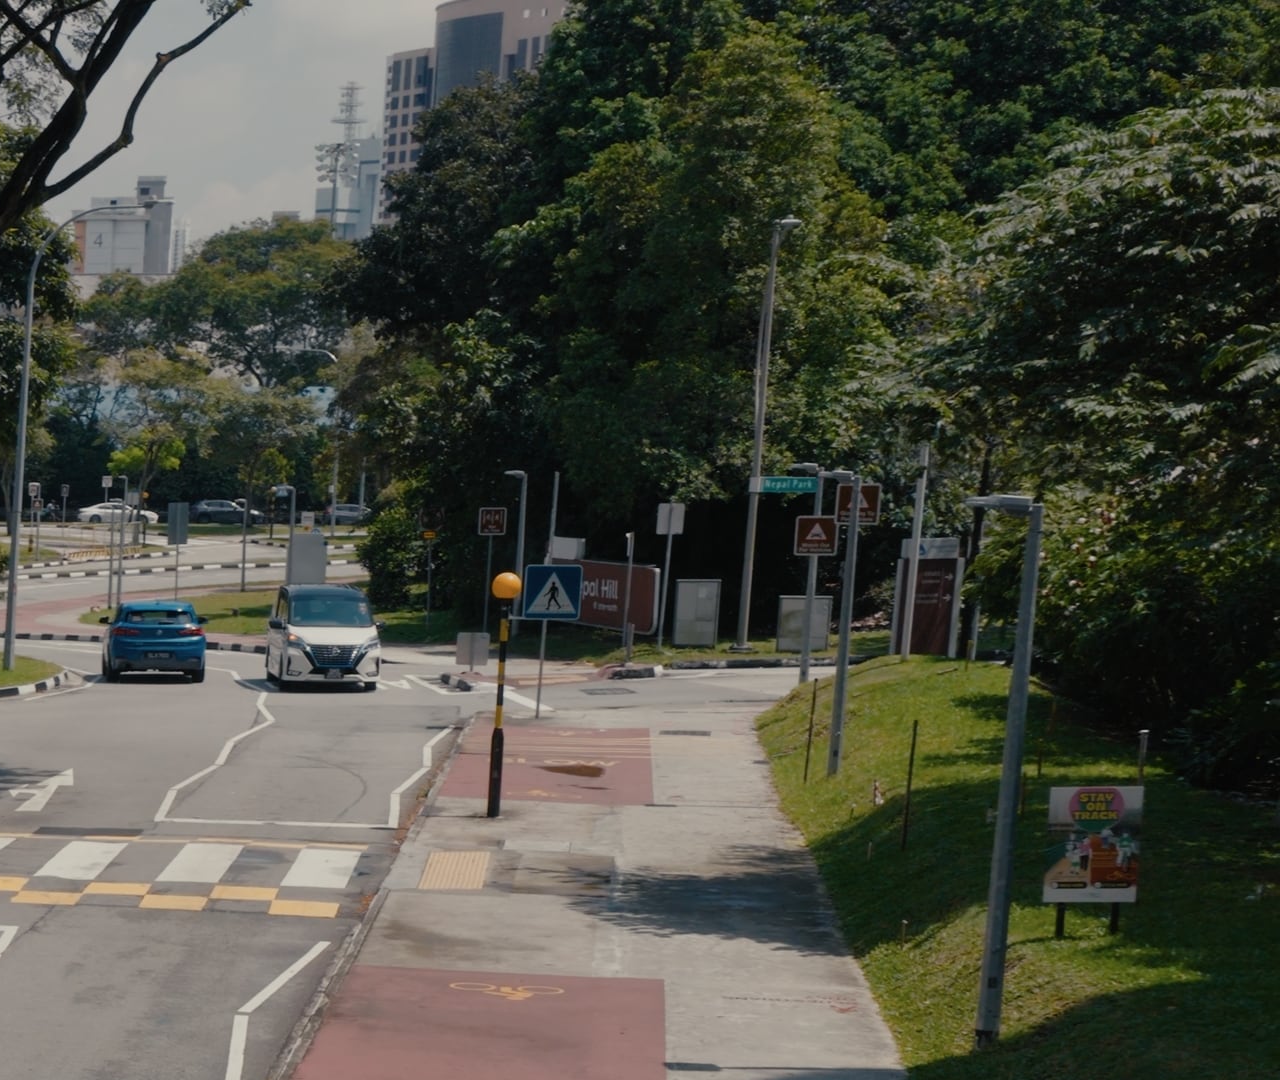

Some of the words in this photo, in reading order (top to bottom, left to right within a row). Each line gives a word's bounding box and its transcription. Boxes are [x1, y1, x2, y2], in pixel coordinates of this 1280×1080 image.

[94, 232, 103, 248] 4
[765, 479, 790, 490] Nepal
[792, 479, 812, 488] Park
[583, 578, 599, 600] pal
[601, 578, 618, 600] Hill
[1079, 793, 1114, 802] STAY
[1086, 802, 1105, 811] ON
[1072, 811, 1118, 820] TRACK
